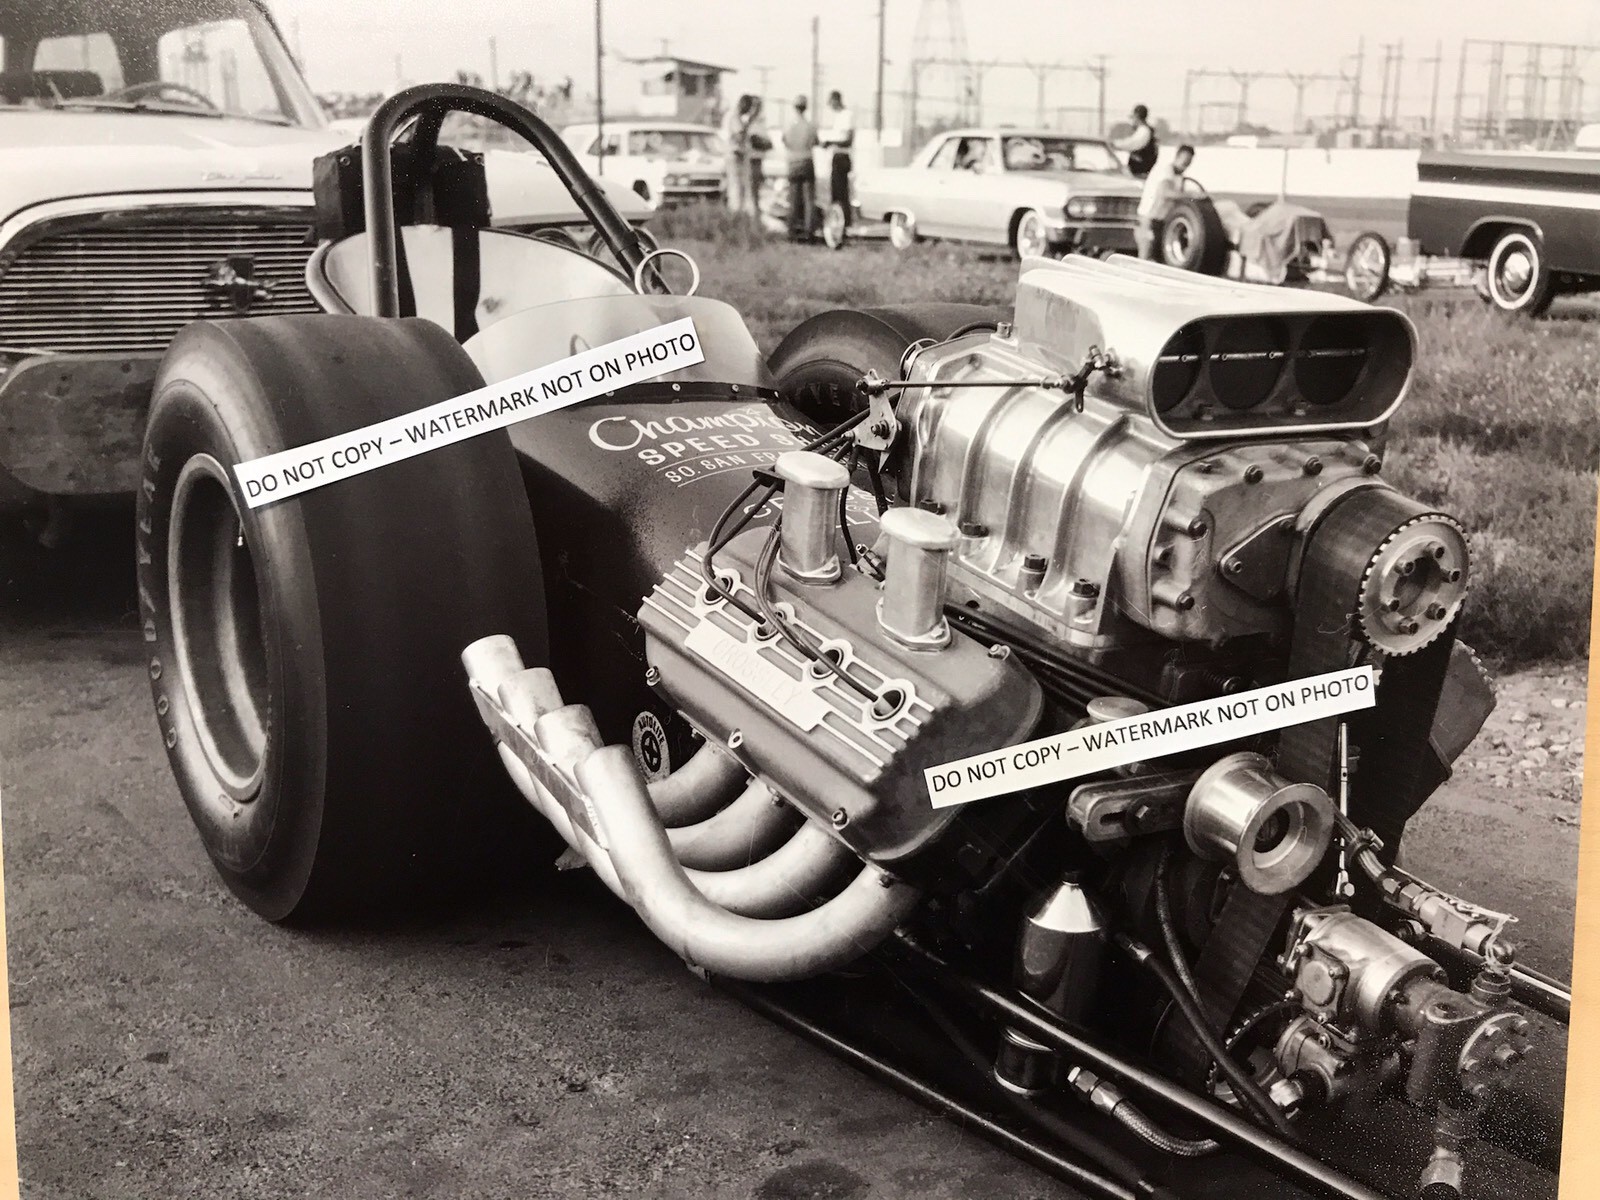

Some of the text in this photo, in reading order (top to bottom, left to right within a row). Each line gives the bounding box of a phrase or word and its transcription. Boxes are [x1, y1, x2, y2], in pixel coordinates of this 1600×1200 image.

[637, 423, 761, 466] SPEED
[664, 465, 702, 483] SO.
[702, 454, 747, 471] SAN
